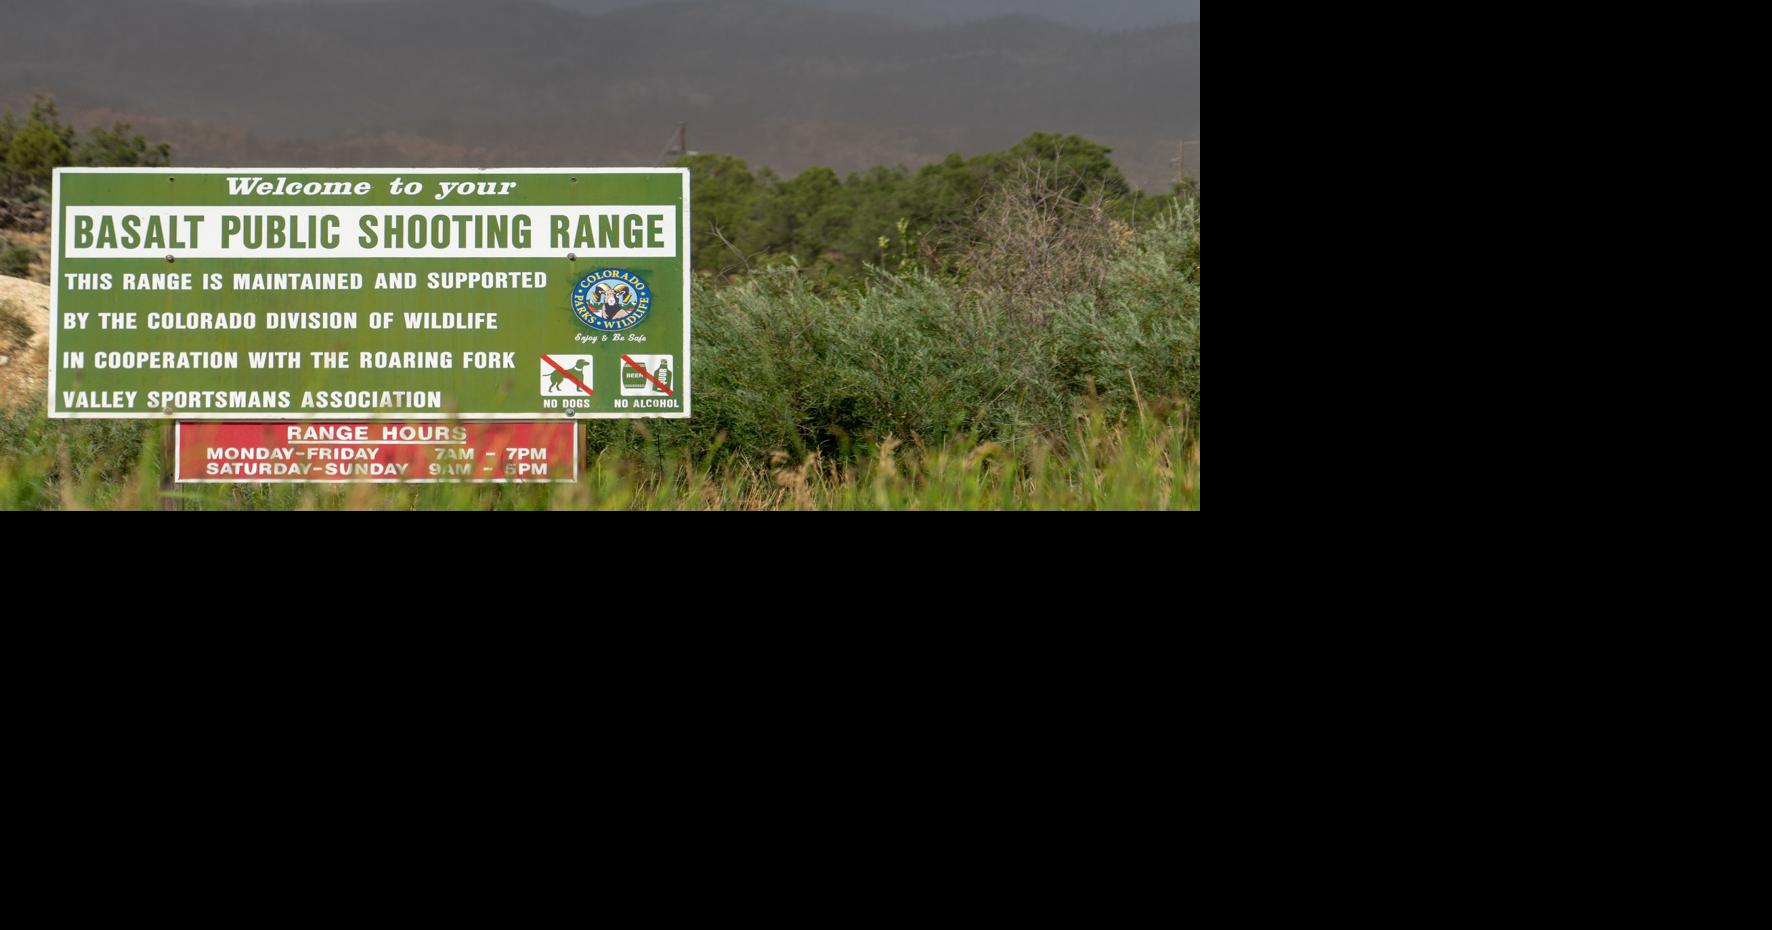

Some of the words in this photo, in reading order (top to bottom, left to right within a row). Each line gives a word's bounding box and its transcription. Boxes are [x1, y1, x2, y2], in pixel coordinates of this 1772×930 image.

[226, 177, 371, 196] Welcome
[389, 177, 423, 196] to
[434, 181, 517, 200] your
[74, 214, 205, 250] BASALT
[221, 214, 340, 250] PUBLIC
[358, 213, 532, 249] SHOOTING
[550, 213, 665, 249] RANGE
[65, 273, 113, 290] THIS
[123, 273, 193, 290] RANGE
[202, 273, 223, 290] IS
[233, 272, 363, 290] MAINTAINED
[374, 272, 417, 290] AND
[427, 271, 548, 290] SUPPORTED
[580, 269, 645, 291] COLORADO
[574, 294, 596, 324] PARKS
[603, 297, 649, 329] WILDLIFE
[63, 312, 90, 330] BY
[98, 312, 138, 330] THE
[147, 312, 257, 330] COLORADO
[266, 312, 358, 330] DIVISION
[369, 312, 394, 330] OF
[404, 312, 498, 330] WILDLIFE
[574, 332, 598, 344] Enjoy
[601, 334, 609, 342] &
[612, 333, 625, 342] Be
[628, 333, 647, 344] Safe
[63, 351, 85, 369] IN
[94, 351, 238, 369] COOPERATION
[248, 351, 301, 369] WITH
[310, 351, 350, 369] THE
[359, 351, 453, 369] ROARING
[463, 351, 516, 369] FORK
[63, 390, 138, 409] VALLEY
[146, 390, 291, 409] SPORTSMANS
[300, 390, 442, 409] ASSOCIATION
[543, 398, 558, 409] NO
[562, 398, 591, 409] DOGS
[614, 398, 629, 409] NO
[632, 398, 680, 409] ALCOHOL
[287, 426, 369, 441] RANGE
[382, 426, 467, 441] HOURS
[206, 447, 380, 461] MONDAY-FRIDAY
[434, 447, 475, 461] 7AM
[506, 447, 547, 461] 7PM
[206, 462, 409, 476] SATURDAY-SUNDAY
[428, 463, 472, 476] 9AM
[504, 463, 548, 476] 5PM
